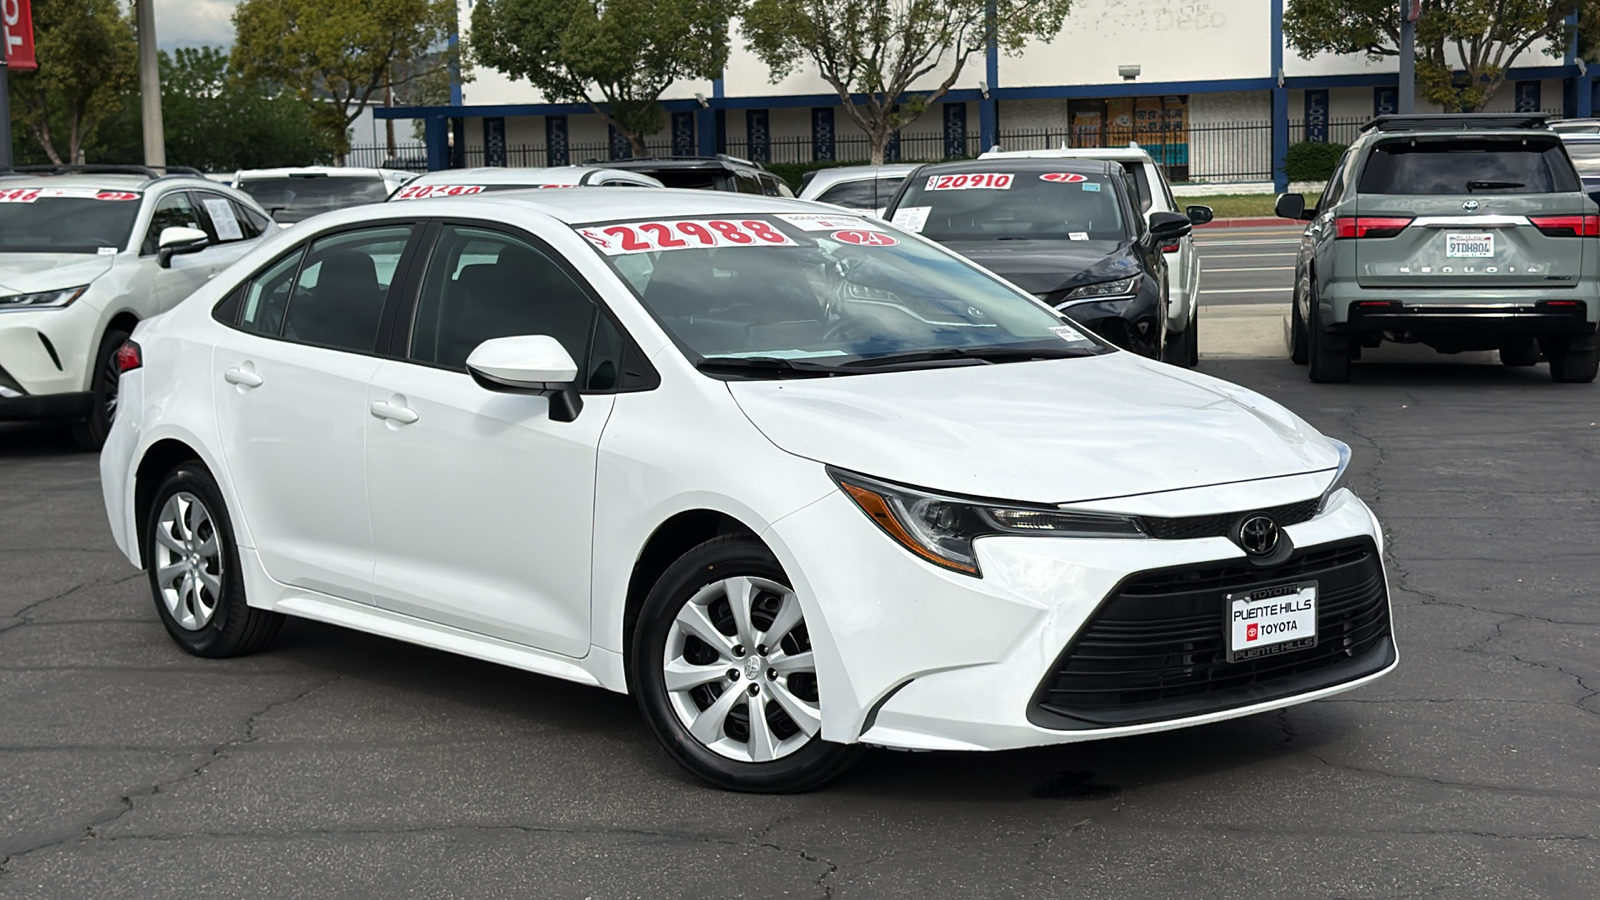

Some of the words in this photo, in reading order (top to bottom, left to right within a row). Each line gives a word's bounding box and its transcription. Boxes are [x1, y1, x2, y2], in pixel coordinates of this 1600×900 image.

[1309, 94, 1323, 144] FLOORIN
[817, 112, 831, 162] FLOORIN
[849, 232, 883, 244] 24
[1450, 243, 1489, 253] 9TDH804
[1251, 584, 1297, 599] TOYOTA
[1233, 604, 1278, 622] PUENTE
[1279, 599, 1312, 614] HILLS
[1260, 620, 1298, 635] TOYOTA
[1235, 645, 1279, 661] PUENTE
[1281, 638, 1313, 652] HILLS
